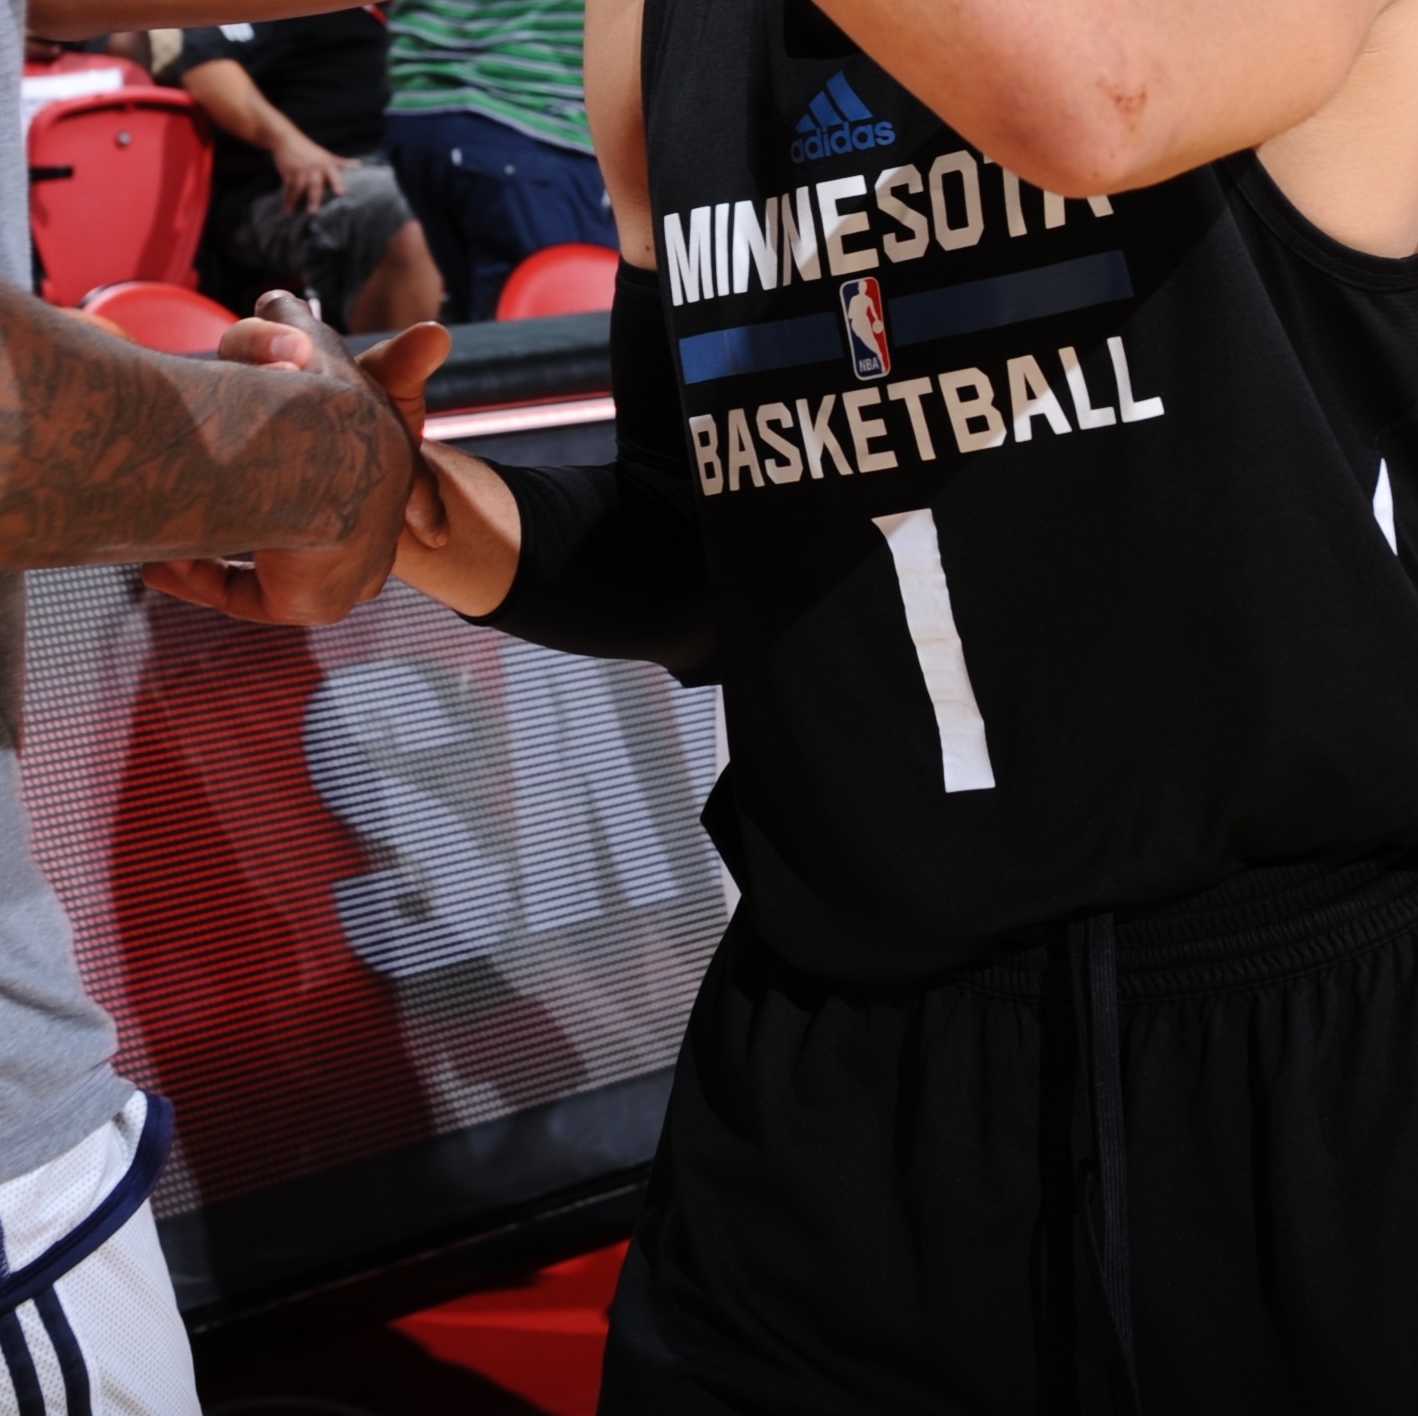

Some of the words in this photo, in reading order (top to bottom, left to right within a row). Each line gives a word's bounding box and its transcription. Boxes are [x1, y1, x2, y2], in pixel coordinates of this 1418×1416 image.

[790, 121, 897, 164] adidas
[858, 356, 880, 373] NBA
[688, 335, 1165, 497] BASKETBALL
[871, 508, 996, 794] 1
